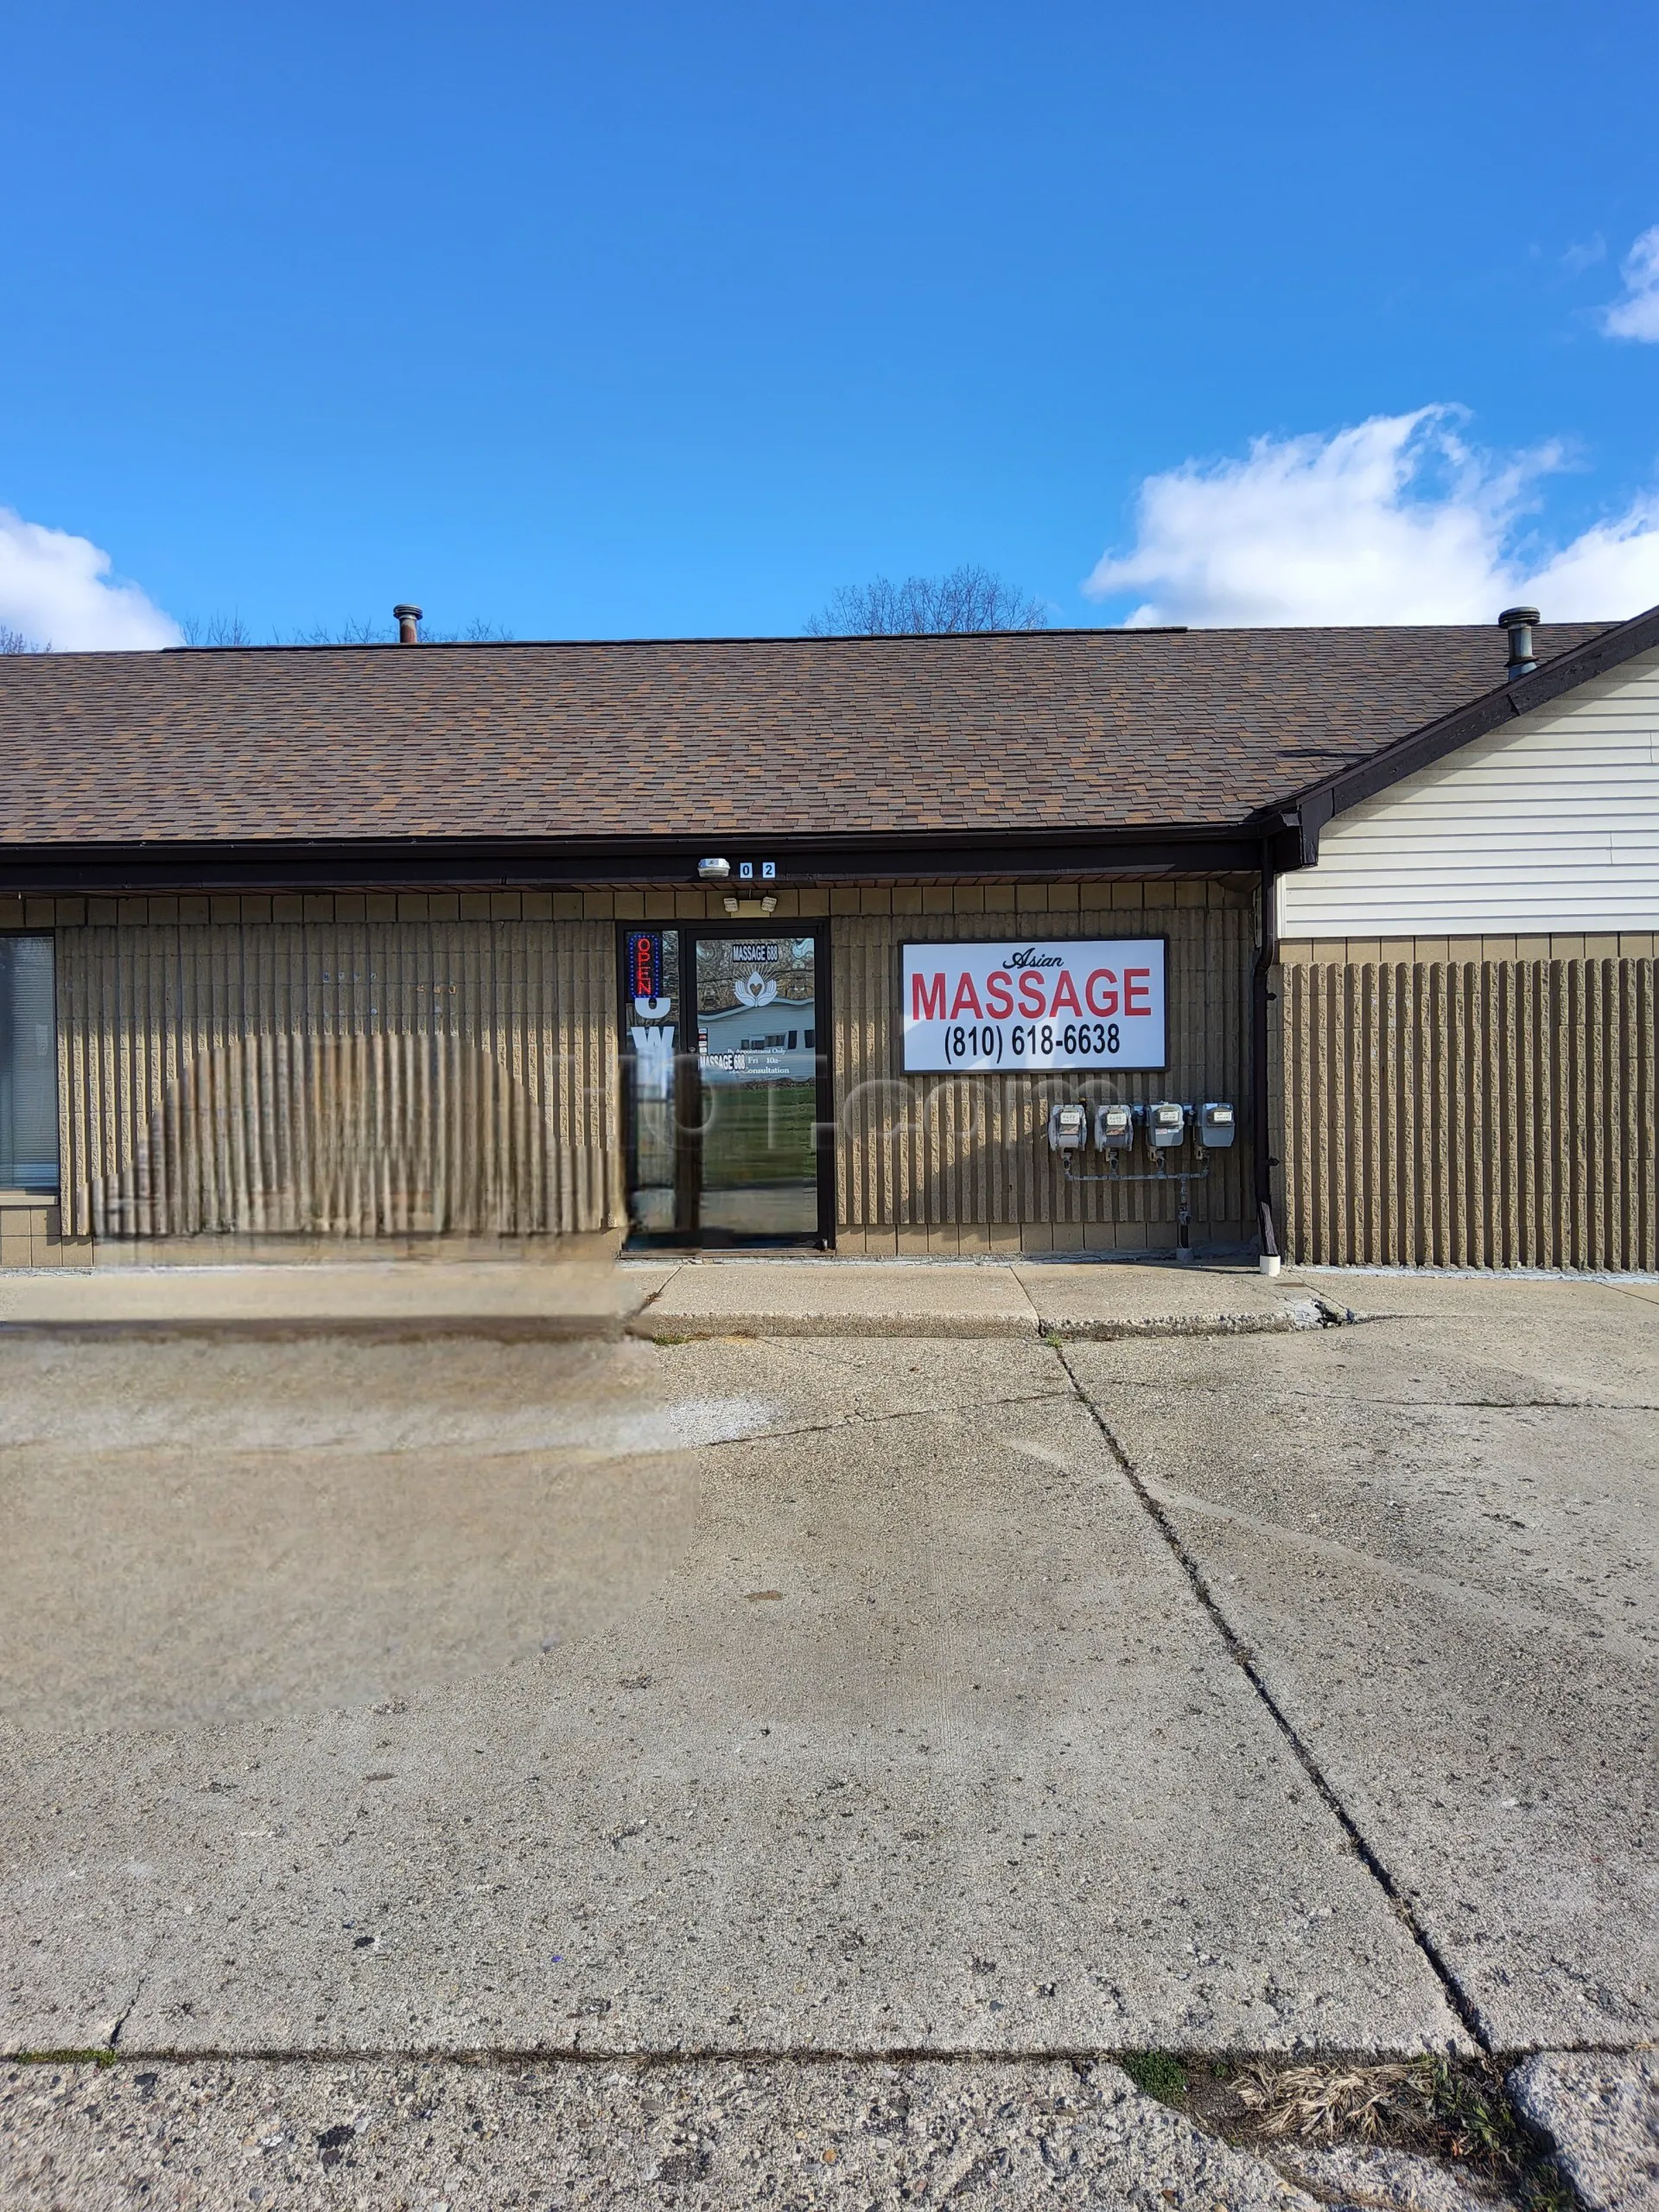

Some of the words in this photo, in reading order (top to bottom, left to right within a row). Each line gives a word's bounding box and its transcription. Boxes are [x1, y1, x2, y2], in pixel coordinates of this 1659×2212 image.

[638, 936, 651, 995] OPEN
[733, 945, 766, 961] MASSAGE
[766, 944, 778, 961] 688
[1002, 948, 1064, 969] Asian
[912, 968, 1152, 1020] MASSAGE
[944, 1026, 1003, 1065] (810)
[1012, 1023, 1120, 1056] 618-6638
[699, 1053, 733, 1070] MASSAGE
[734, 1053, 745, 1071] 688
